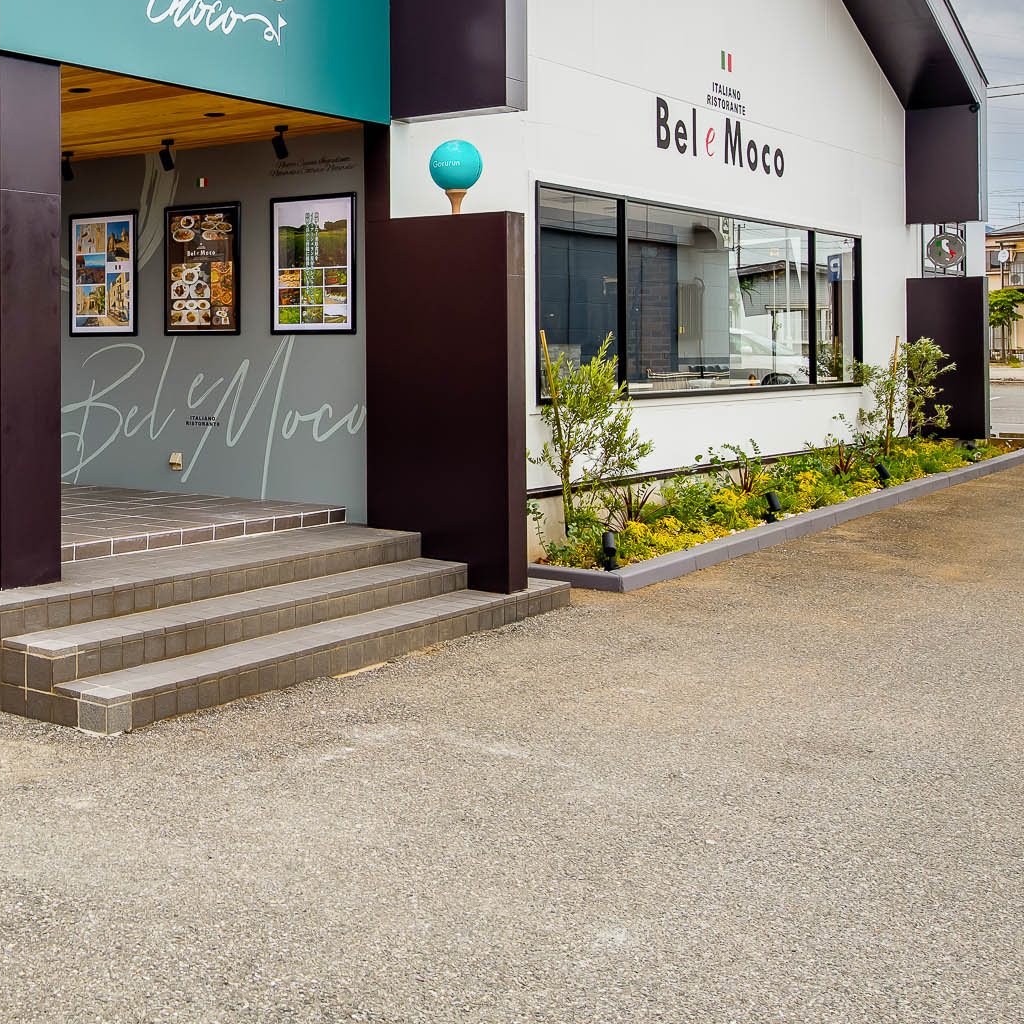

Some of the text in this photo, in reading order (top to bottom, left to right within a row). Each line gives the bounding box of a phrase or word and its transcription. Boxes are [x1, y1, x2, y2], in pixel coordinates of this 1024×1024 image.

[712, 81, 741, 101] ITALIANO
[706, 94, 746, 116] RISTORANTE
[656, 96, 785, 178] Bel e Moco
